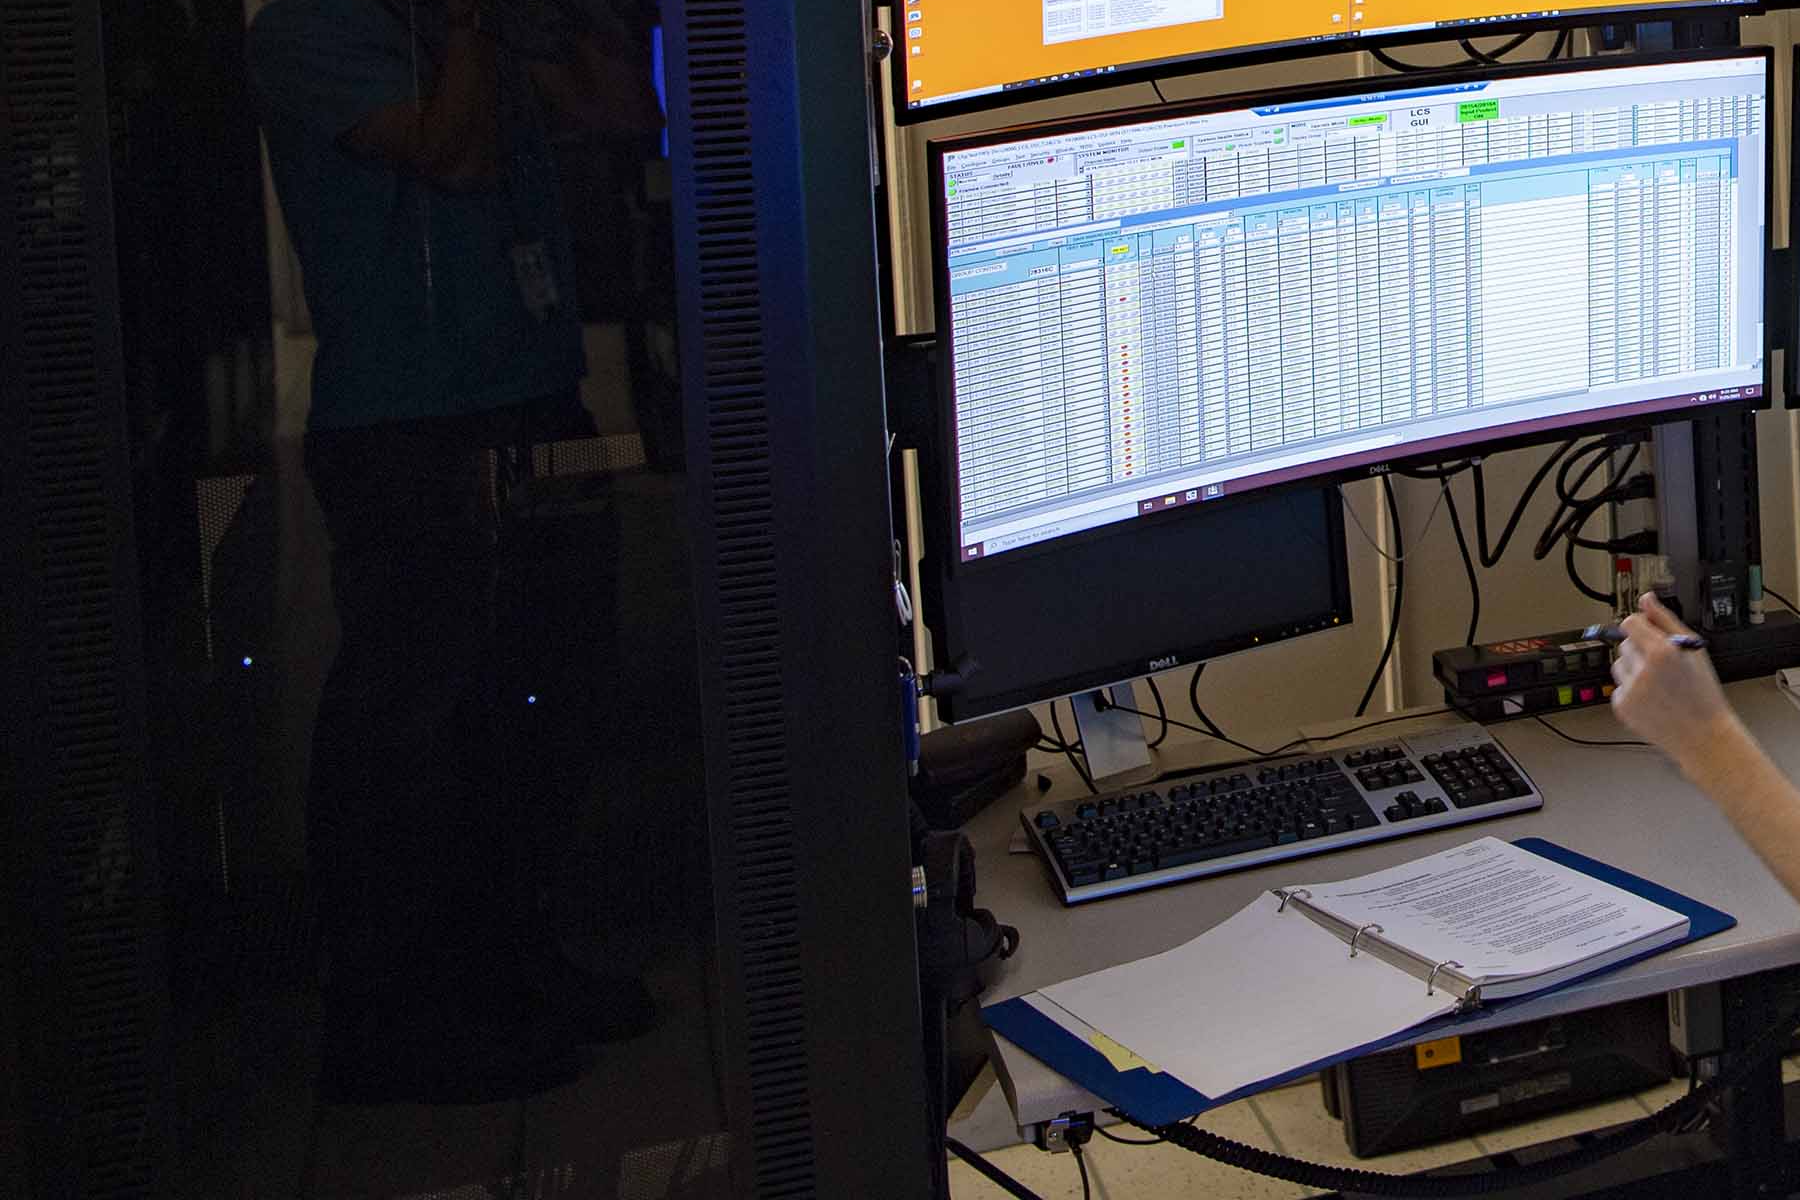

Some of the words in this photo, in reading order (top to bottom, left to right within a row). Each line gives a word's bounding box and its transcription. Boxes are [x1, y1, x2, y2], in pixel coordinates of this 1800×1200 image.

[1410, 108, 1431, 117] LCS
[1410, 118, 1429, 127] GUI
[1149, 655, 1179, 671] DELL
